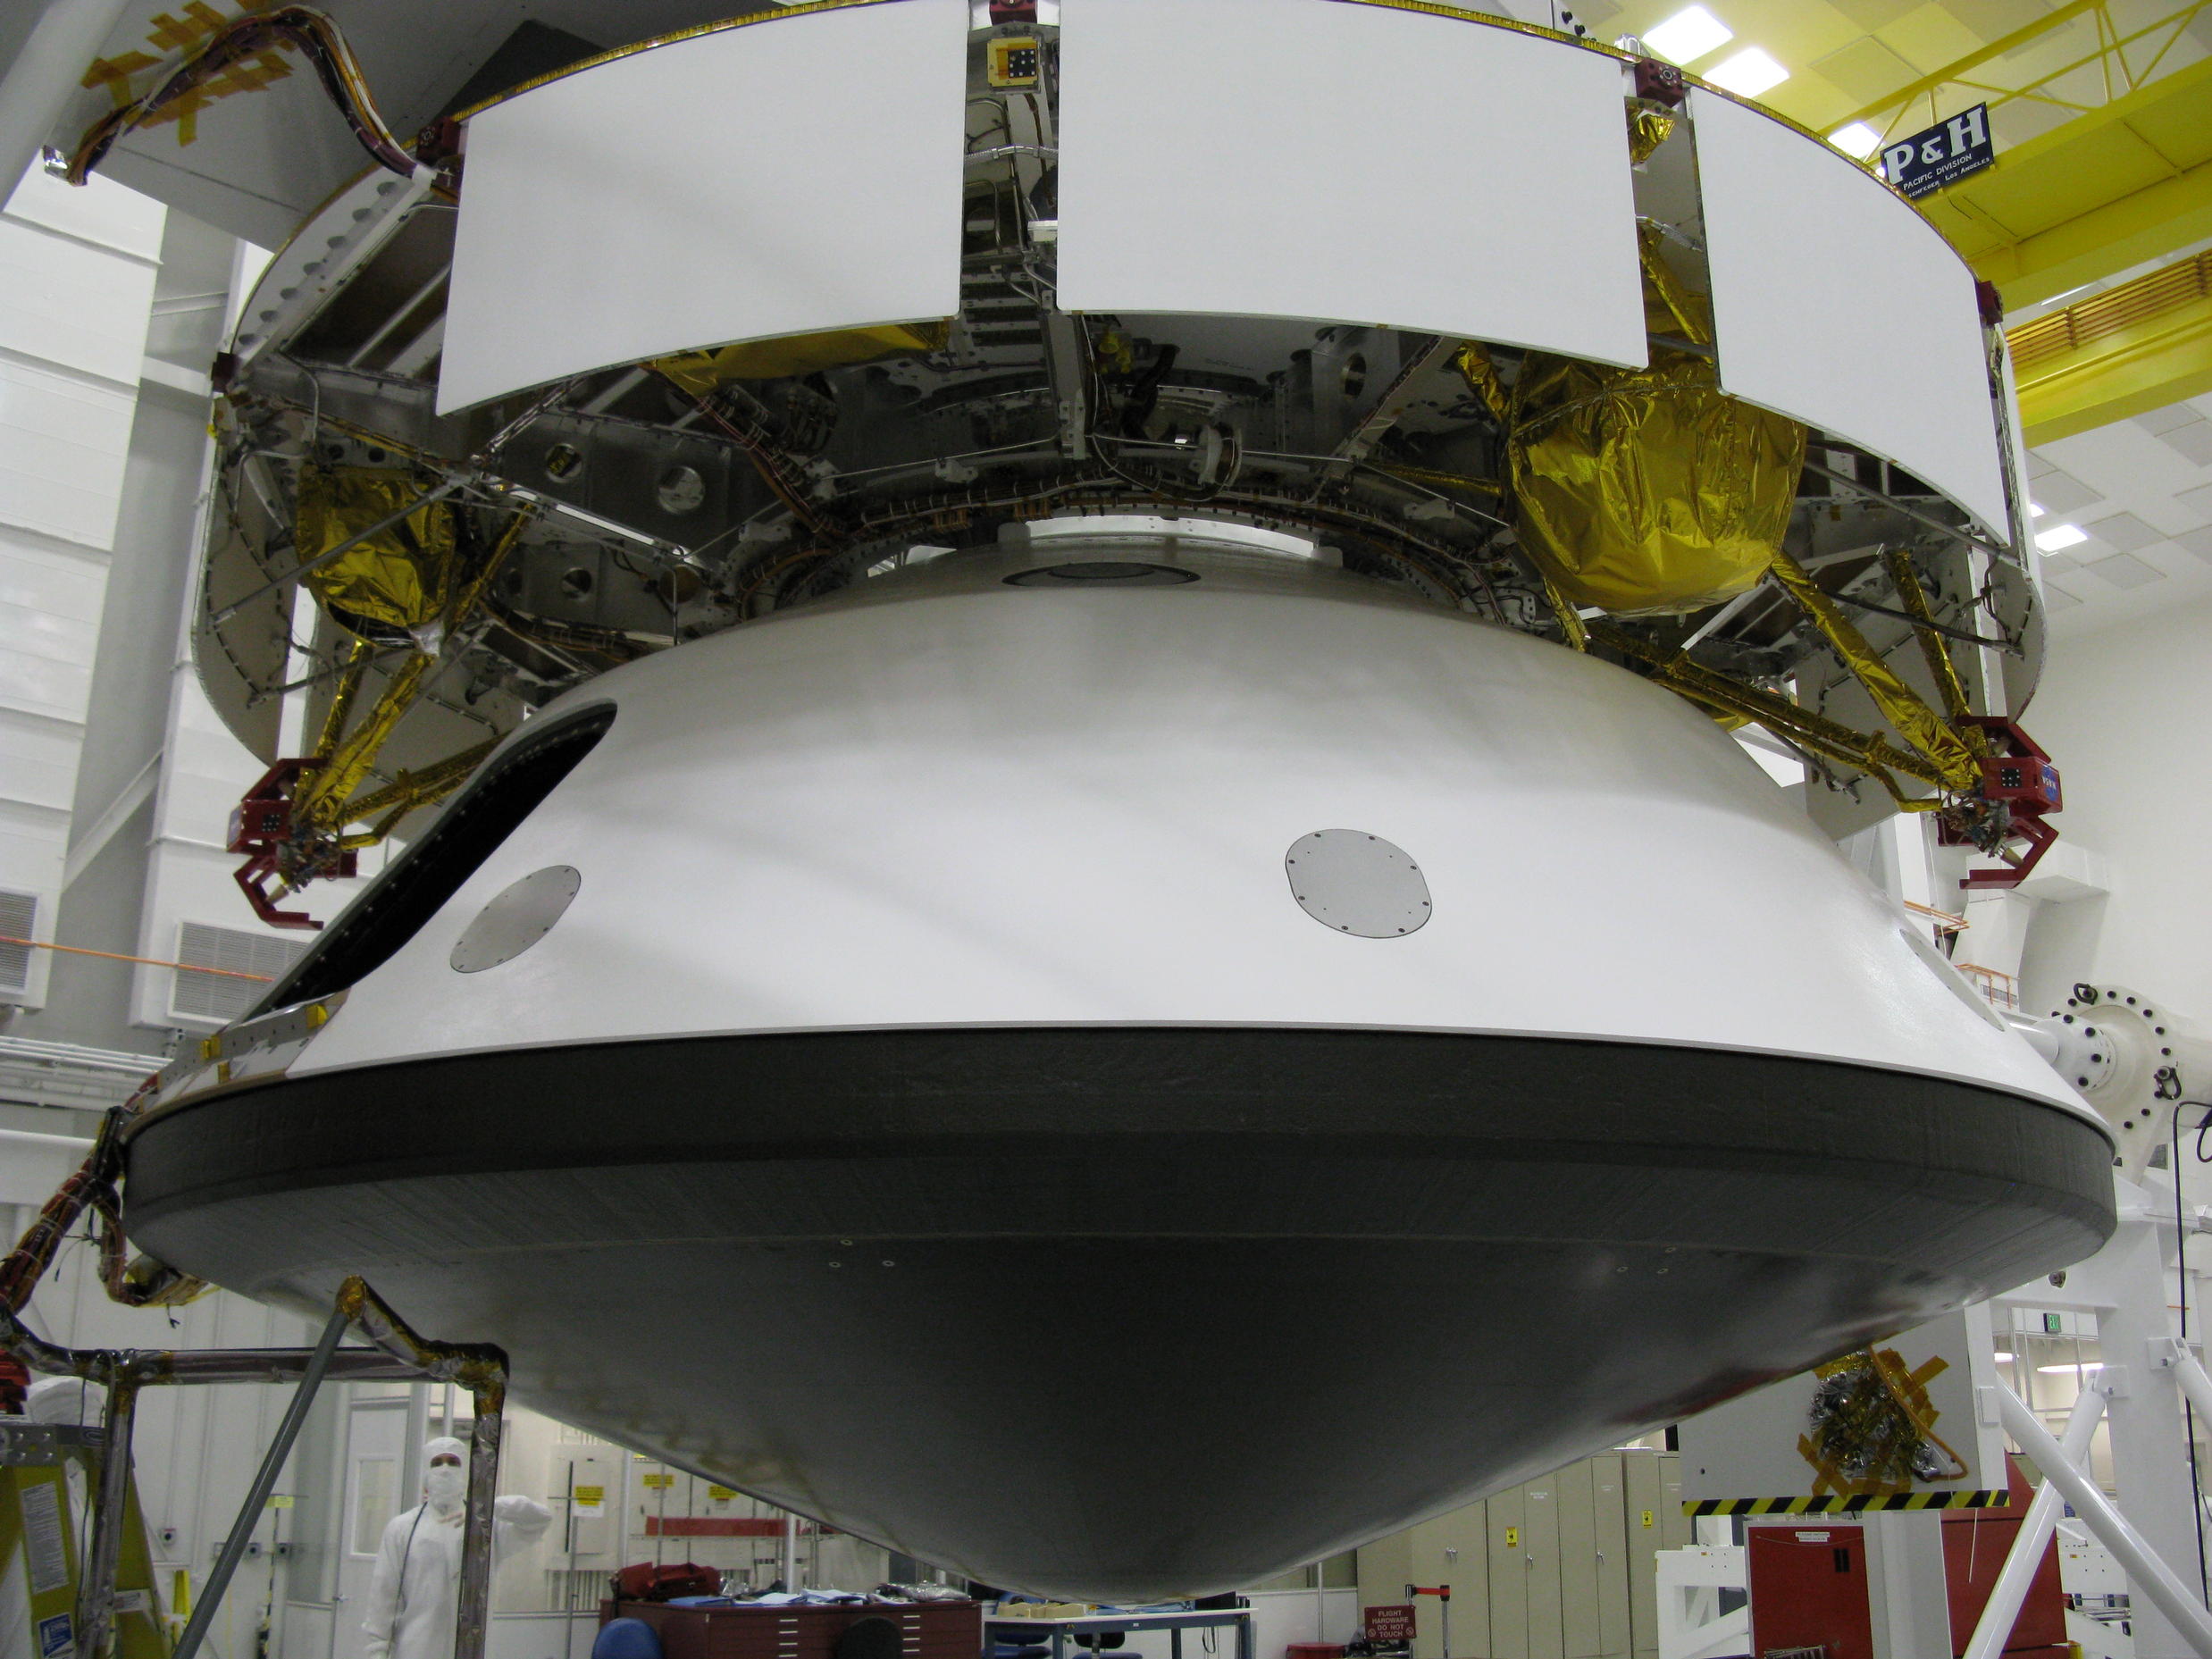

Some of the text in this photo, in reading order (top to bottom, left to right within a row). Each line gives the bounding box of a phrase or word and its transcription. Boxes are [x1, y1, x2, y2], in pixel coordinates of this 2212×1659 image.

[1903, 153, 1973, 191] PACIFIC DIVISION
[2049, 1314, 2059, 1330] EXIT
[1371, 1616, 1409, 1624] HARDWARE
